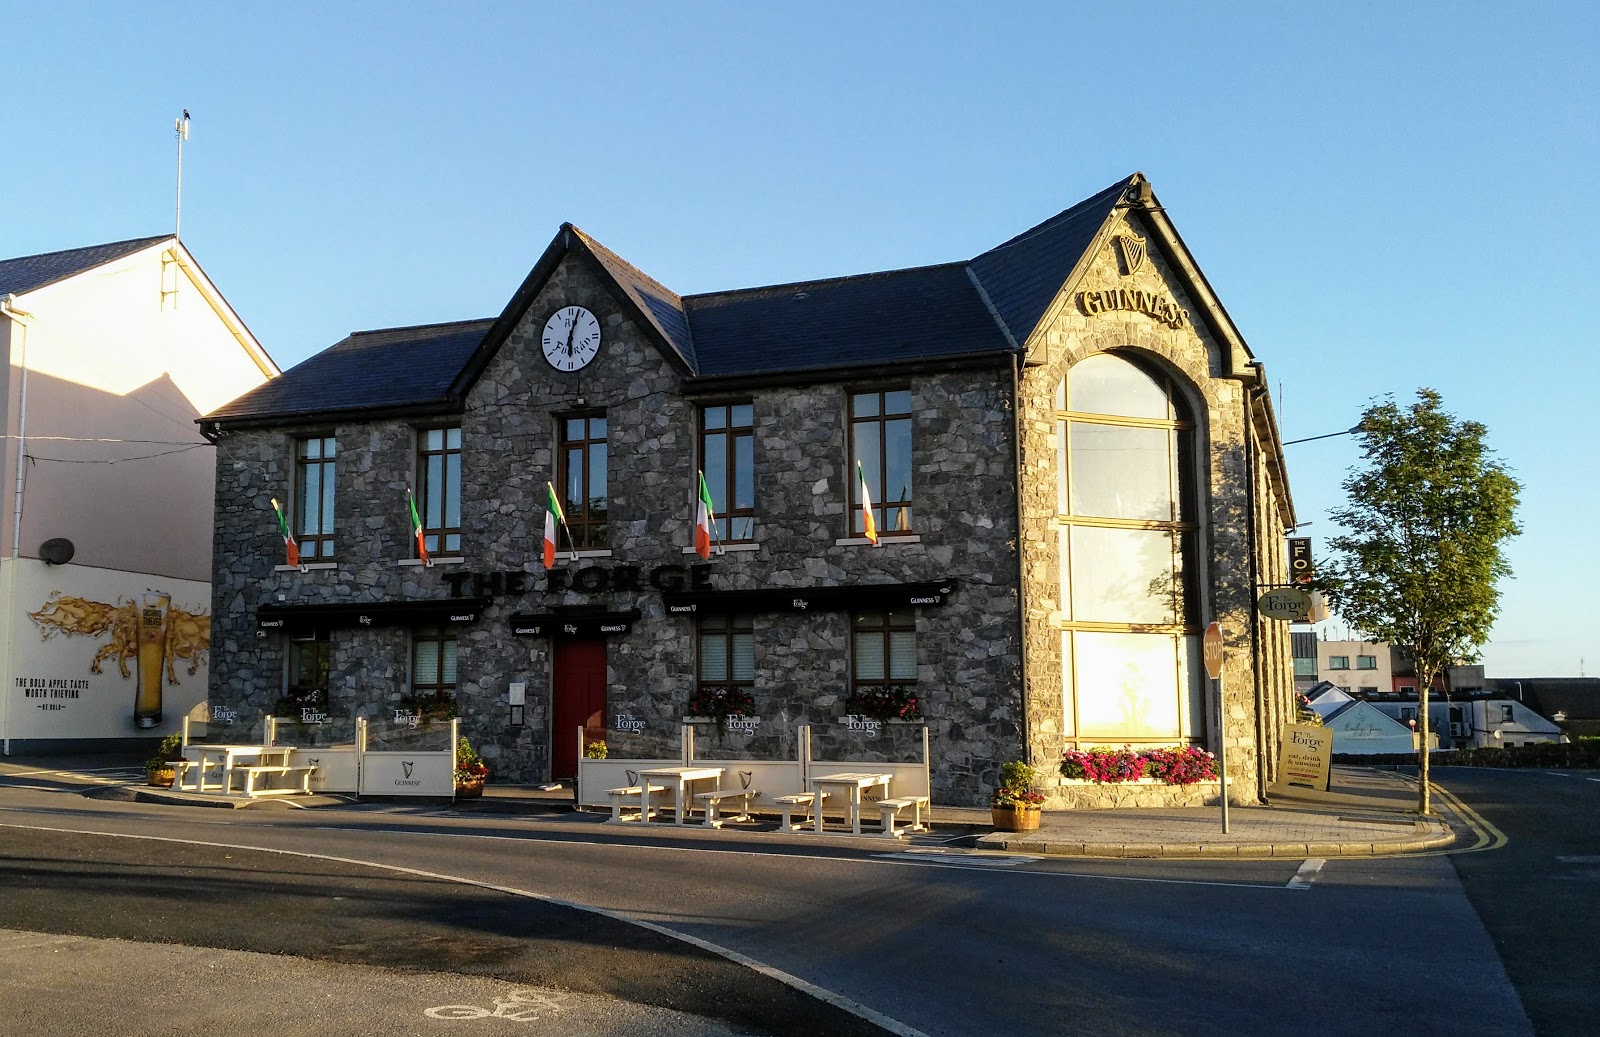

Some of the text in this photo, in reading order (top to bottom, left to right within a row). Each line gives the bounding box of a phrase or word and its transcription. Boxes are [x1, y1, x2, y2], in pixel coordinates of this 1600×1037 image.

[1083, 287, 1190, 328] GUINNESS
[441, 564, 713, 598] THE FORGE
[1265, 596, 1305, 617] Forge
[1205, 640, 1222, 661] STOP
[15, 678, 89, 689] THE BOLD APPLE TASTE
[25, 688, 79, 699] WORTH THIEVING
[213, 705, 238, 724] Forge
[300, 707, 326, 727] Forge
[394, 709, 421, 730] Forge
[615, 714, 646, 736] Forge
[726, 714, 760, 736] Forge
[846, 714, 882, 738] Forge
[1290, 730, 1324, 752] Forge
[394, 779, 420, 787] GUINNESS
